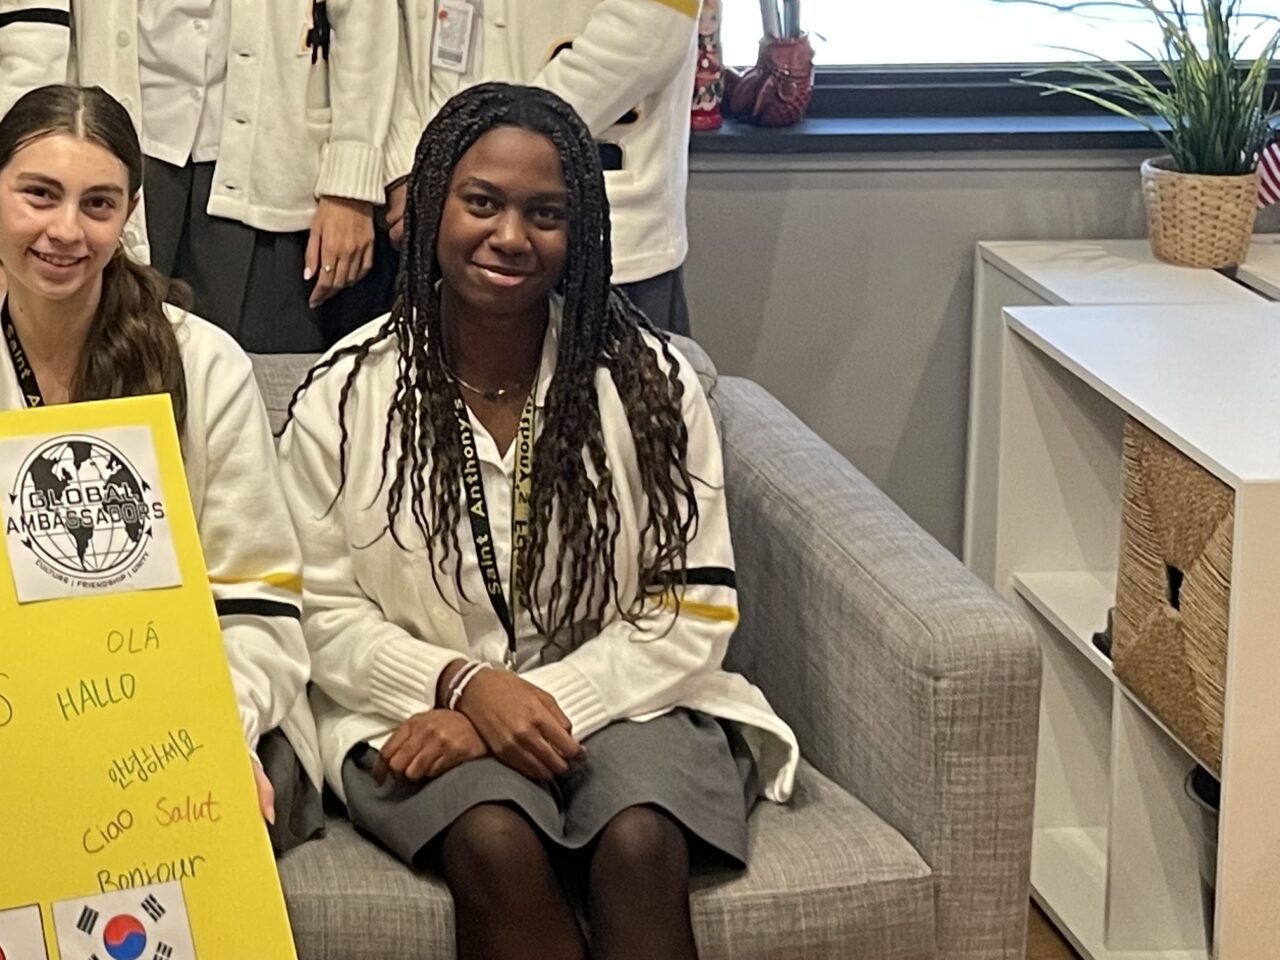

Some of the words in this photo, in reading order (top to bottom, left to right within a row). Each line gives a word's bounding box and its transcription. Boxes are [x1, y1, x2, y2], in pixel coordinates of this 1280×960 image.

[6, 324, 31, 380] Saint
[454, 398, 485, 517] Anthony's
[6, 501, 166, 536] AMBASSADORS
[28, 482, 140, 509] GLOBAL
[476, 533, 500, 595] Saint
[106, 620, 160, 654] OLÁ
[57, 673, 135, 721] HALLO
[108, 729, 204, 790] 안녕하세요
[82, 809, 134, 855] Ciao
[156, 791, 222, 827] Salut
